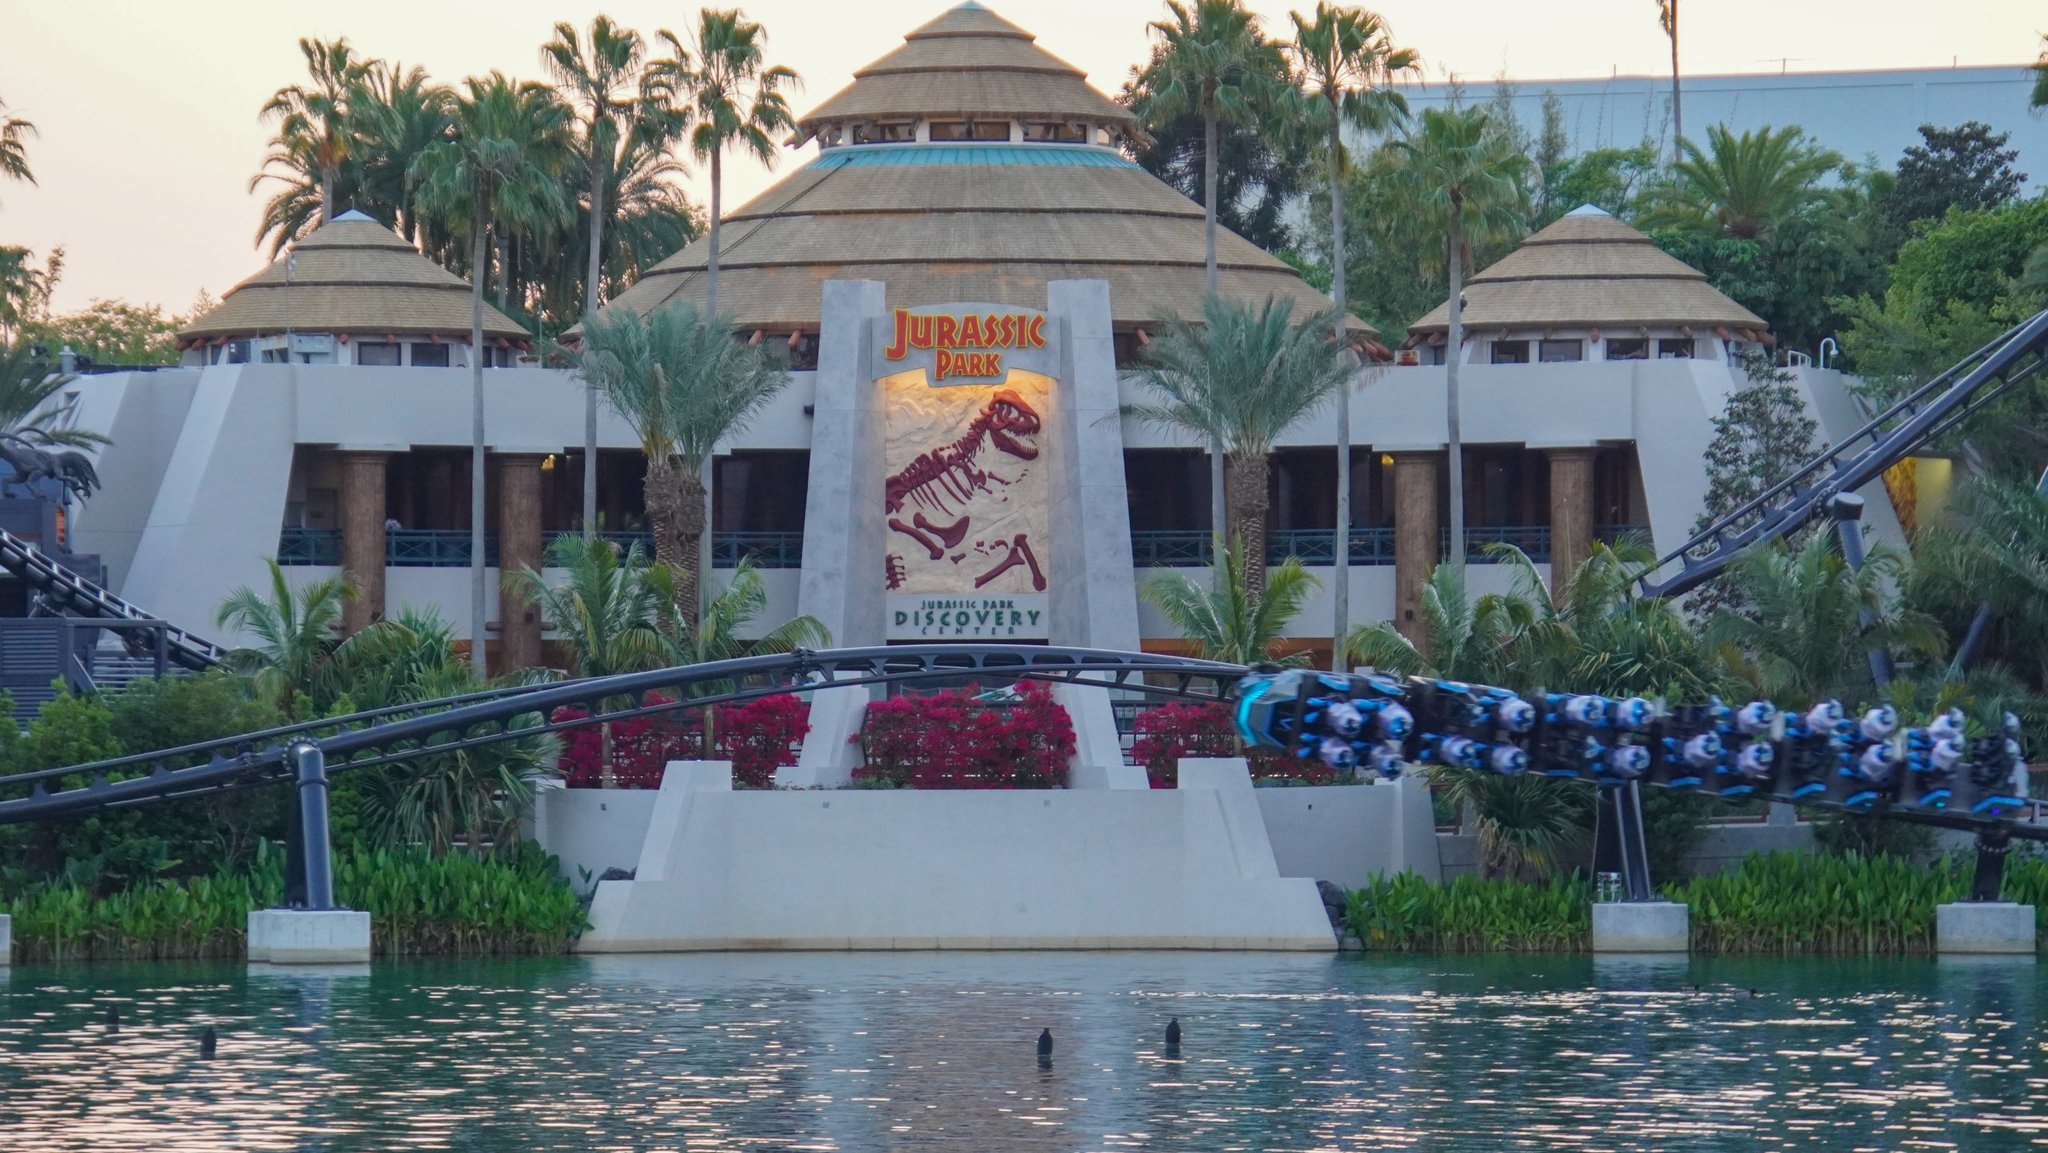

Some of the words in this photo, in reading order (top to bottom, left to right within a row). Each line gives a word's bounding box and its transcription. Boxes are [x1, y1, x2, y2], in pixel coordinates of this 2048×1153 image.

[885, 306, 1047, 360] JURASSIC
[935, 348, 1001, 380] PARK
[921, 600, 976, 610] JURASSIC
[983, 600, 1014, 609] PARK
[895, 610, 1041, 627] DISCOVERY
[921, 627, 1014, 635] CENTER
